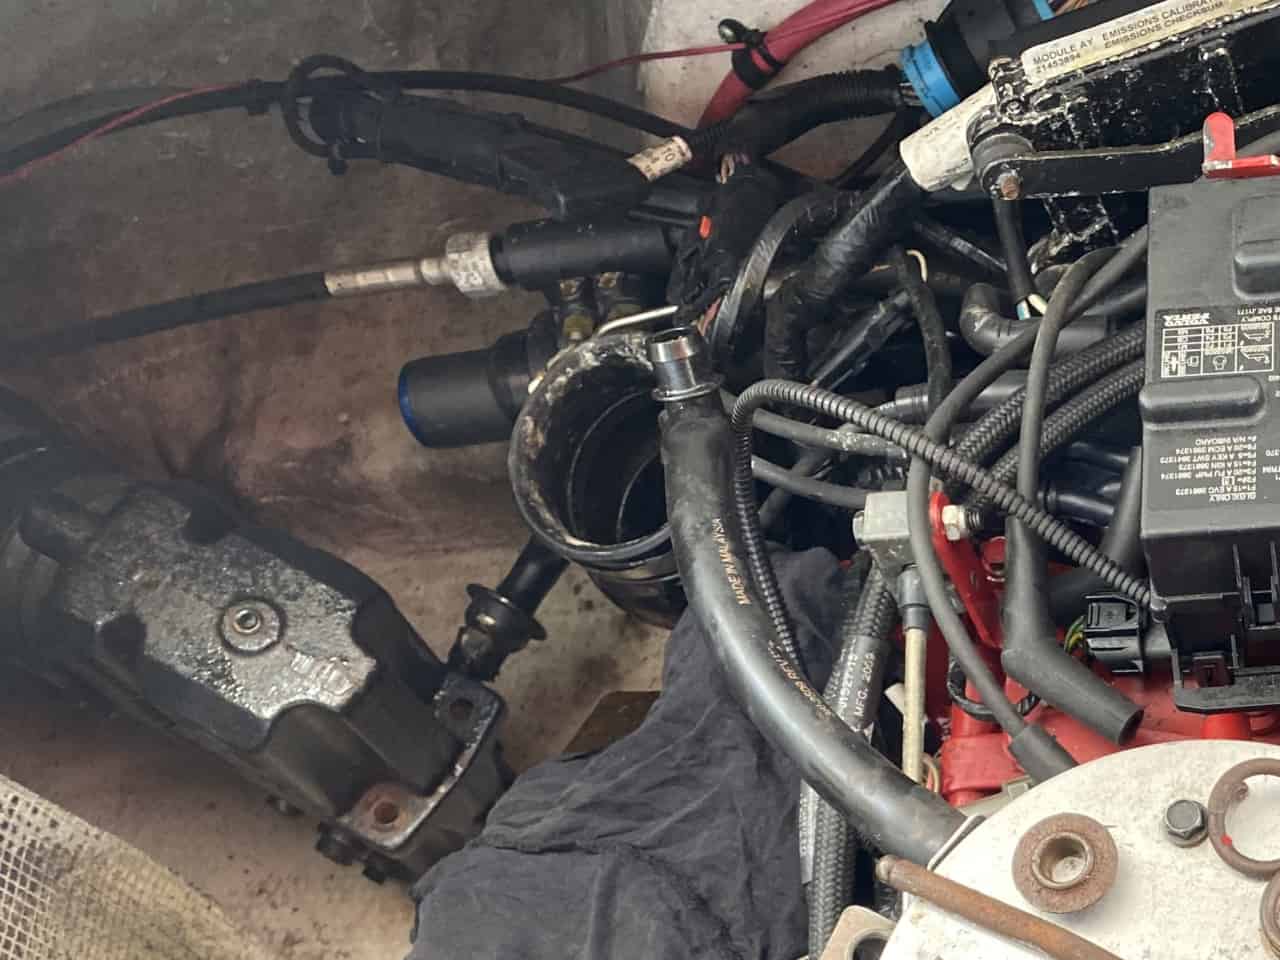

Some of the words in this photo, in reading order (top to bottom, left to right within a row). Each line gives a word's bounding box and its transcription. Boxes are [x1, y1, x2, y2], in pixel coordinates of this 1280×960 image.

[1033, 42, 1078, 65] MODULE
[1102, 15, 1160, 41] EMISSIONS
[1104, 23, 1162, 49] EMISSIONS
[712, 517, 733, 564] MALAYSIA
